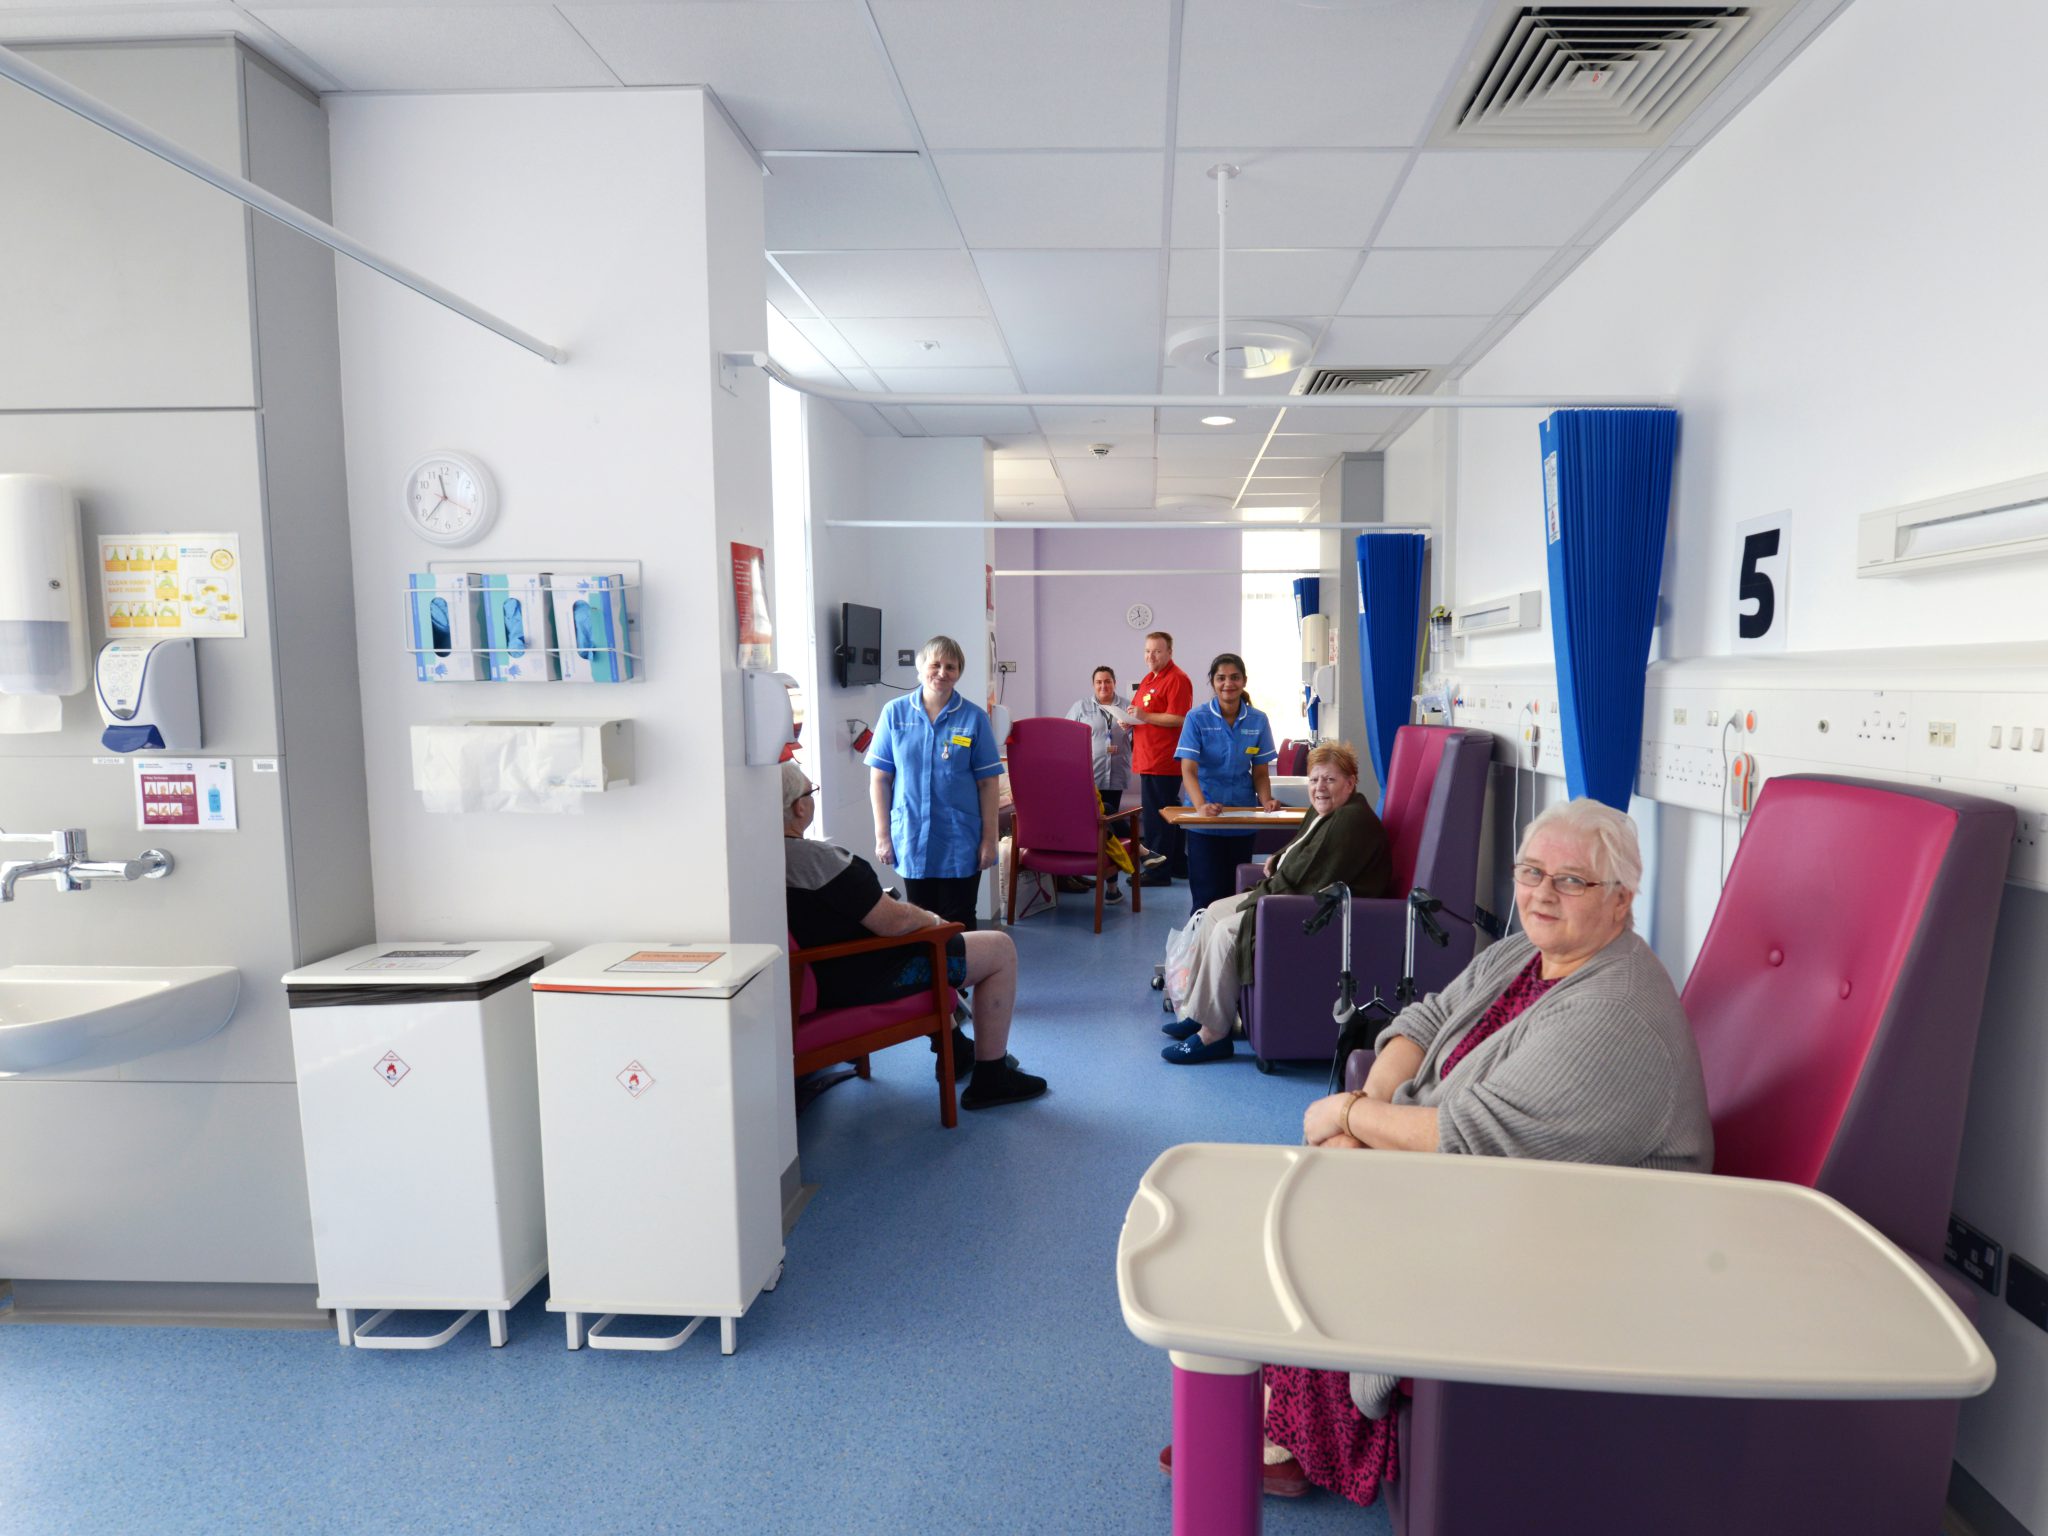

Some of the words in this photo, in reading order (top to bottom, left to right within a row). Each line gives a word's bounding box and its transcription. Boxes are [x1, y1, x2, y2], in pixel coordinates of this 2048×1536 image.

[440, 466, 449, 475] 12
[428, 471, 436, 480] 11
[420, 481, 429, 489] 10
[465, 480, 472, 489] 2
[415, 494, 422, 503] 9
[422, 508, 428, 517] 8
[445, 520, 451, 529] 6
[1739, 528, 1781, 639] 5
